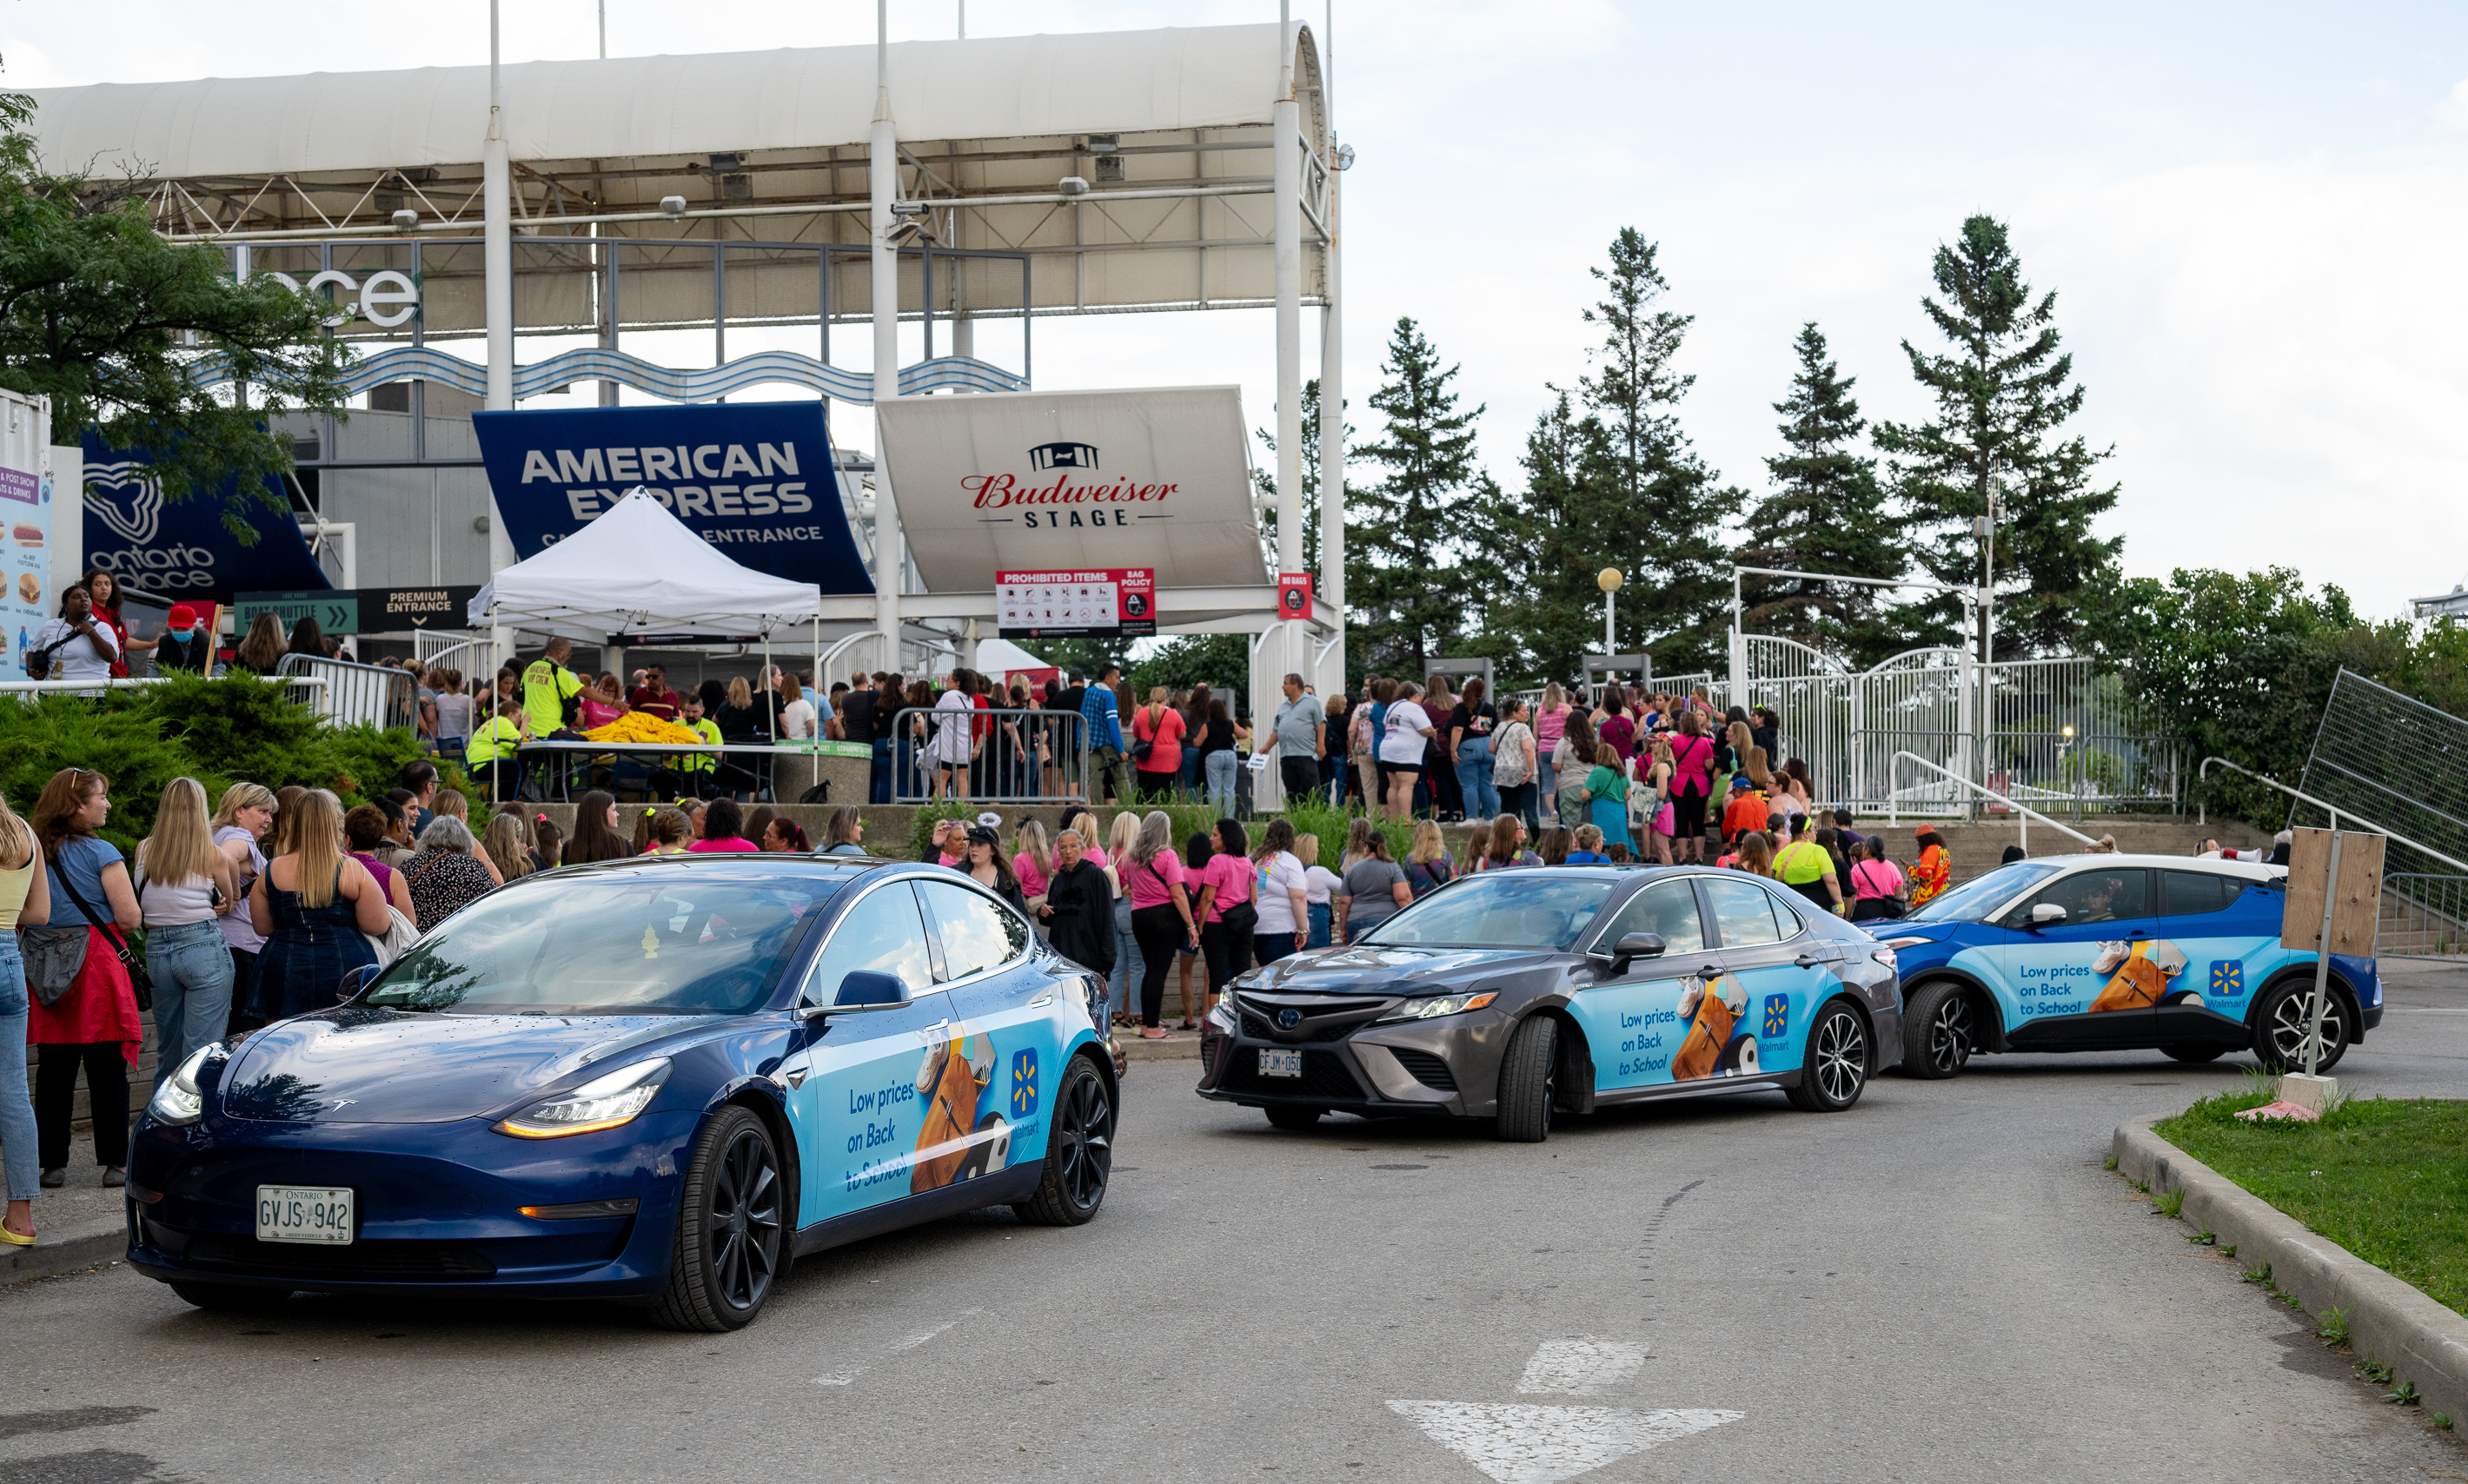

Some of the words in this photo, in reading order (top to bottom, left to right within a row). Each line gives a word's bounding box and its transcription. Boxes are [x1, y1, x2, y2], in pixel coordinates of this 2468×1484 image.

[521, 441, 799, 484] AMERICAN
[5, 473, 19, 484] POST
[20, 476, 36, 487] SHOW
[13, 487, 31, 500] DRINKS
[960, 474, 1180, 509] Budweiser
[1024, 509, 1128, 528] STAGE
[702, 526, 824, 544] ENTRANCE
[90, 542, 215, 571] ontario
[1005, 573, 1072, 583] PROHIBITED
[1073, 572, 1108, 582] ITEMS
[1282, 576, 1290, 585] NO
[1291, 576, 1307, 585] BAGS
[390, 591, 448, 602] PREMIUM
[272, 605, 316, 618] SHUTTLE
[386, 601, 451, 613] ENTRANCE
[2020, 965, 2047, 978] Low
[2050, 964, 2090, 981] prices
[2020, 985, 2037, 997] on
[2040, 983, 2072, 996] Back
[2020, 1004, 2034, 1016] to
[2037, 1001, 2081, 1015] School
[2206, 998, 2246, 1009] Walmart
[1621, 1012, 1642, 1029] Low
[1645, 1008, 1675, 1030] prices
[1622, 1039, 1635, 1052] on
[1637, 1032, 1662, 1050] Back
[1759, 1040, 1789, 1053] Walmart
[1259, 1054, 1281, 1070] CFJM
[1619, 1062, 1630, 1076] to
[1632, 1054, 1668, 1074] School
[850, 1089, 874, 1115] Low
[878, 1079, 914, 1116] prices
[847, 1134, 863, 1153] on
[866, 1118, 896, 1149] Back
[1012, 1119, 1040, 1141] Walmart
[846, 1170, 861, 1193] to
[864, 1152, 907, 1188] School
[286, 1190, 322, 1200] ONTARIO
[261, 1200, 302, 1228] GVJS
[315, 1202, 348, 1230] 942
